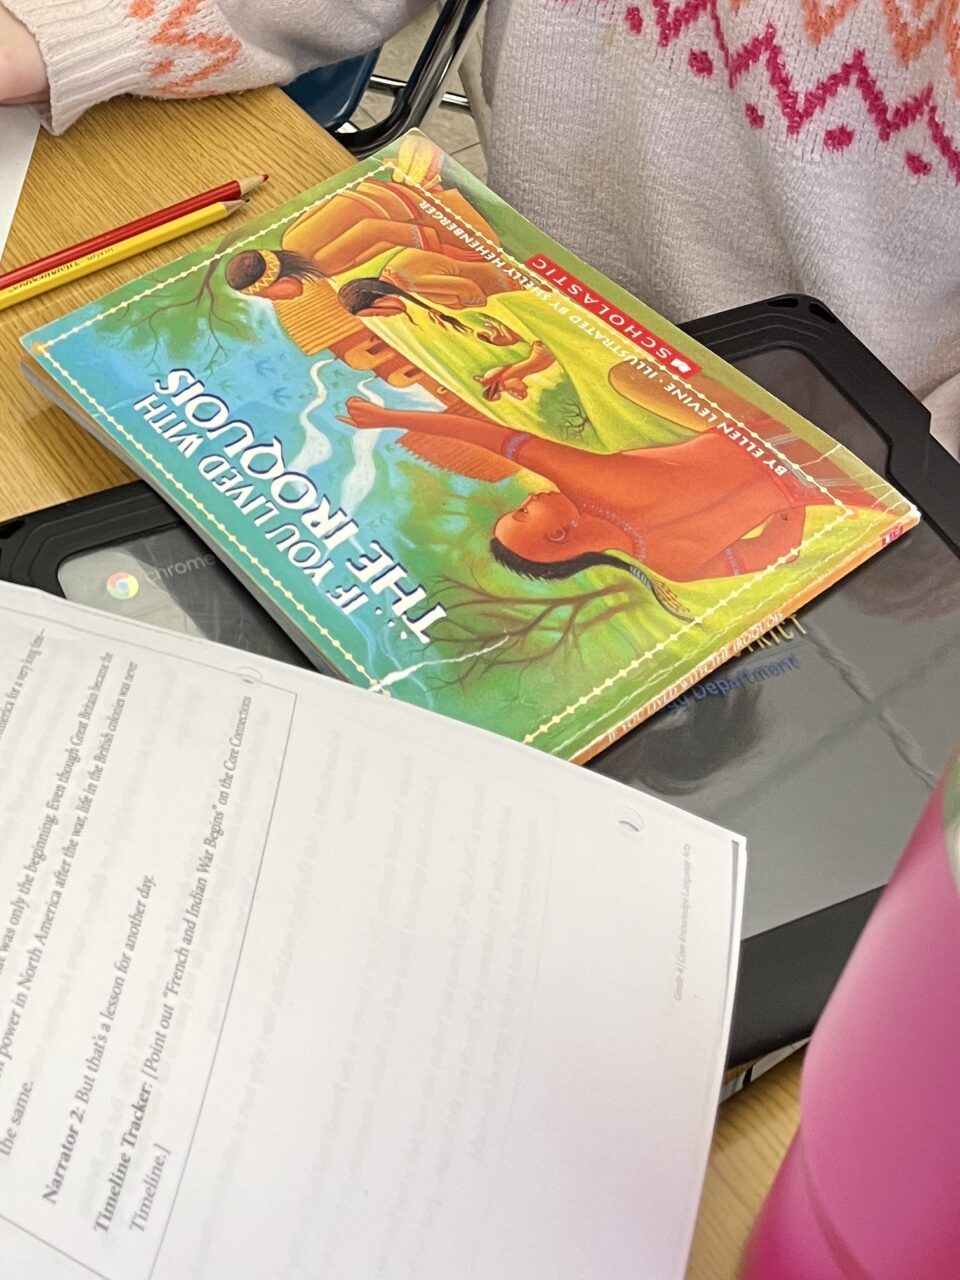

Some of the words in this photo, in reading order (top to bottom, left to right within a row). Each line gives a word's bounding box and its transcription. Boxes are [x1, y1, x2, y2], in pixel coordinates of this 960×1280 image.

[418, 200, 505, 269] HEHENBERGER
[502, 266, 551, 302] SHELLY
[549, 297, 569, 314] BY
[531, 257, 672, 360] SCHOLASTIC
[568, 312, 658, 380] ILLUSTRATED
[664, 382, 718, 424] LEVINE
[133, 393, 204, 459] WITH
[718, 422, 769, 459] ELLEN
[154, 367, 360, 550] IROQUOIS
[764, 458, 788, 477] BY
[198, 455, 280, 527] LIVED
[265, 522, 335, 587] YOU
[345, 540, 447, 644] THE
[693, 656, 801, 700] Department
[223, 747, 240, 771] Core
[45, 783, 67, 812] Even
[23, 813, 60, 873] beginning.
[72, 815, 89, 836] war,
[61, 838, 79, 858] the
[196, 849, 215, 873] War
[17, 873, 35, 895] the
[53, 858, 72, 888] after
[9, 895, 31, 926] only
[33, 889, 63, 946] America
[185, 876, 208, 918] Indian
[0, 927, 16, 952] was
[182, 917, 197, 945] and
[17, 946, 44, 990] North
[160, 1003, 175, 1029] out
[42, 1124, 80, 1204] Narrator
[74, 1074, 96, 1104] But
[99, 975, 126, 1021] lesson
[114, 951, 132, 974] for
[125, 899, 147, 951] another
[136, 874, 157, 899] day.
[141, 1030, 168, 1080] [Point
[11, 1081, 35, 1126] same.
[120, 1081, 153, 1148] Tracker:
[93, 1152, 132, 1232] Timeline
[129, 1142, 172, 1231] Timeline.]
